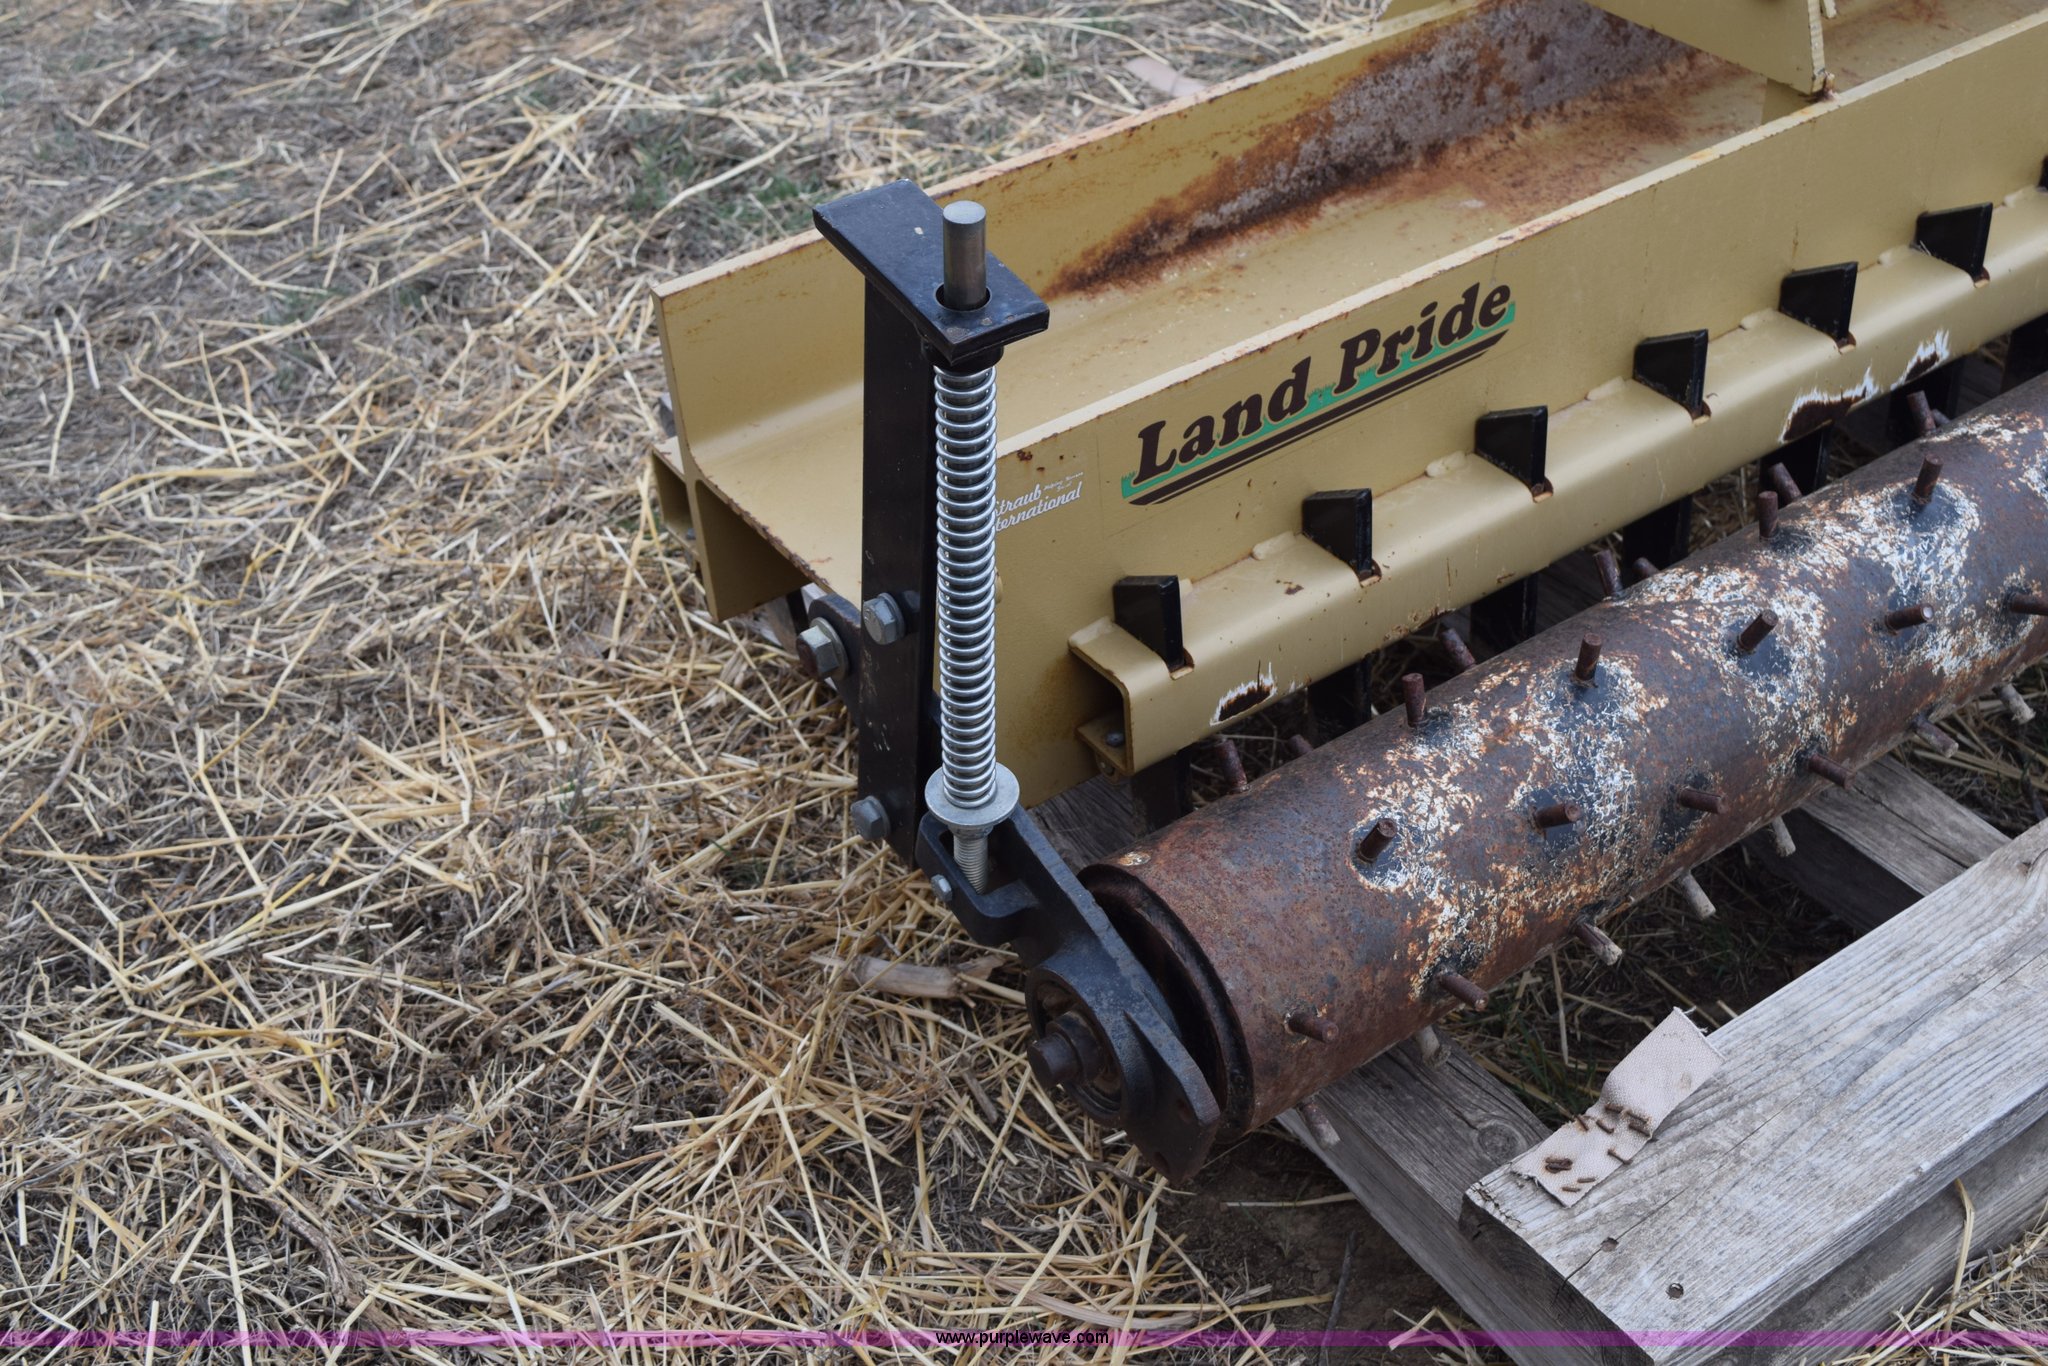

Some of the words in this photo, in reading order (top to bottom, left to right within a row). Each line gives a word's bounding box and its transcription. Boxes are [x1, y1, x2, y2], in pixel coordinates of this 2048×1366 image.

[1132, 356, 1311, 485] Land
[1333, 282, 1511, 395] Pride
[995, 480, 1083, 531] ternational
